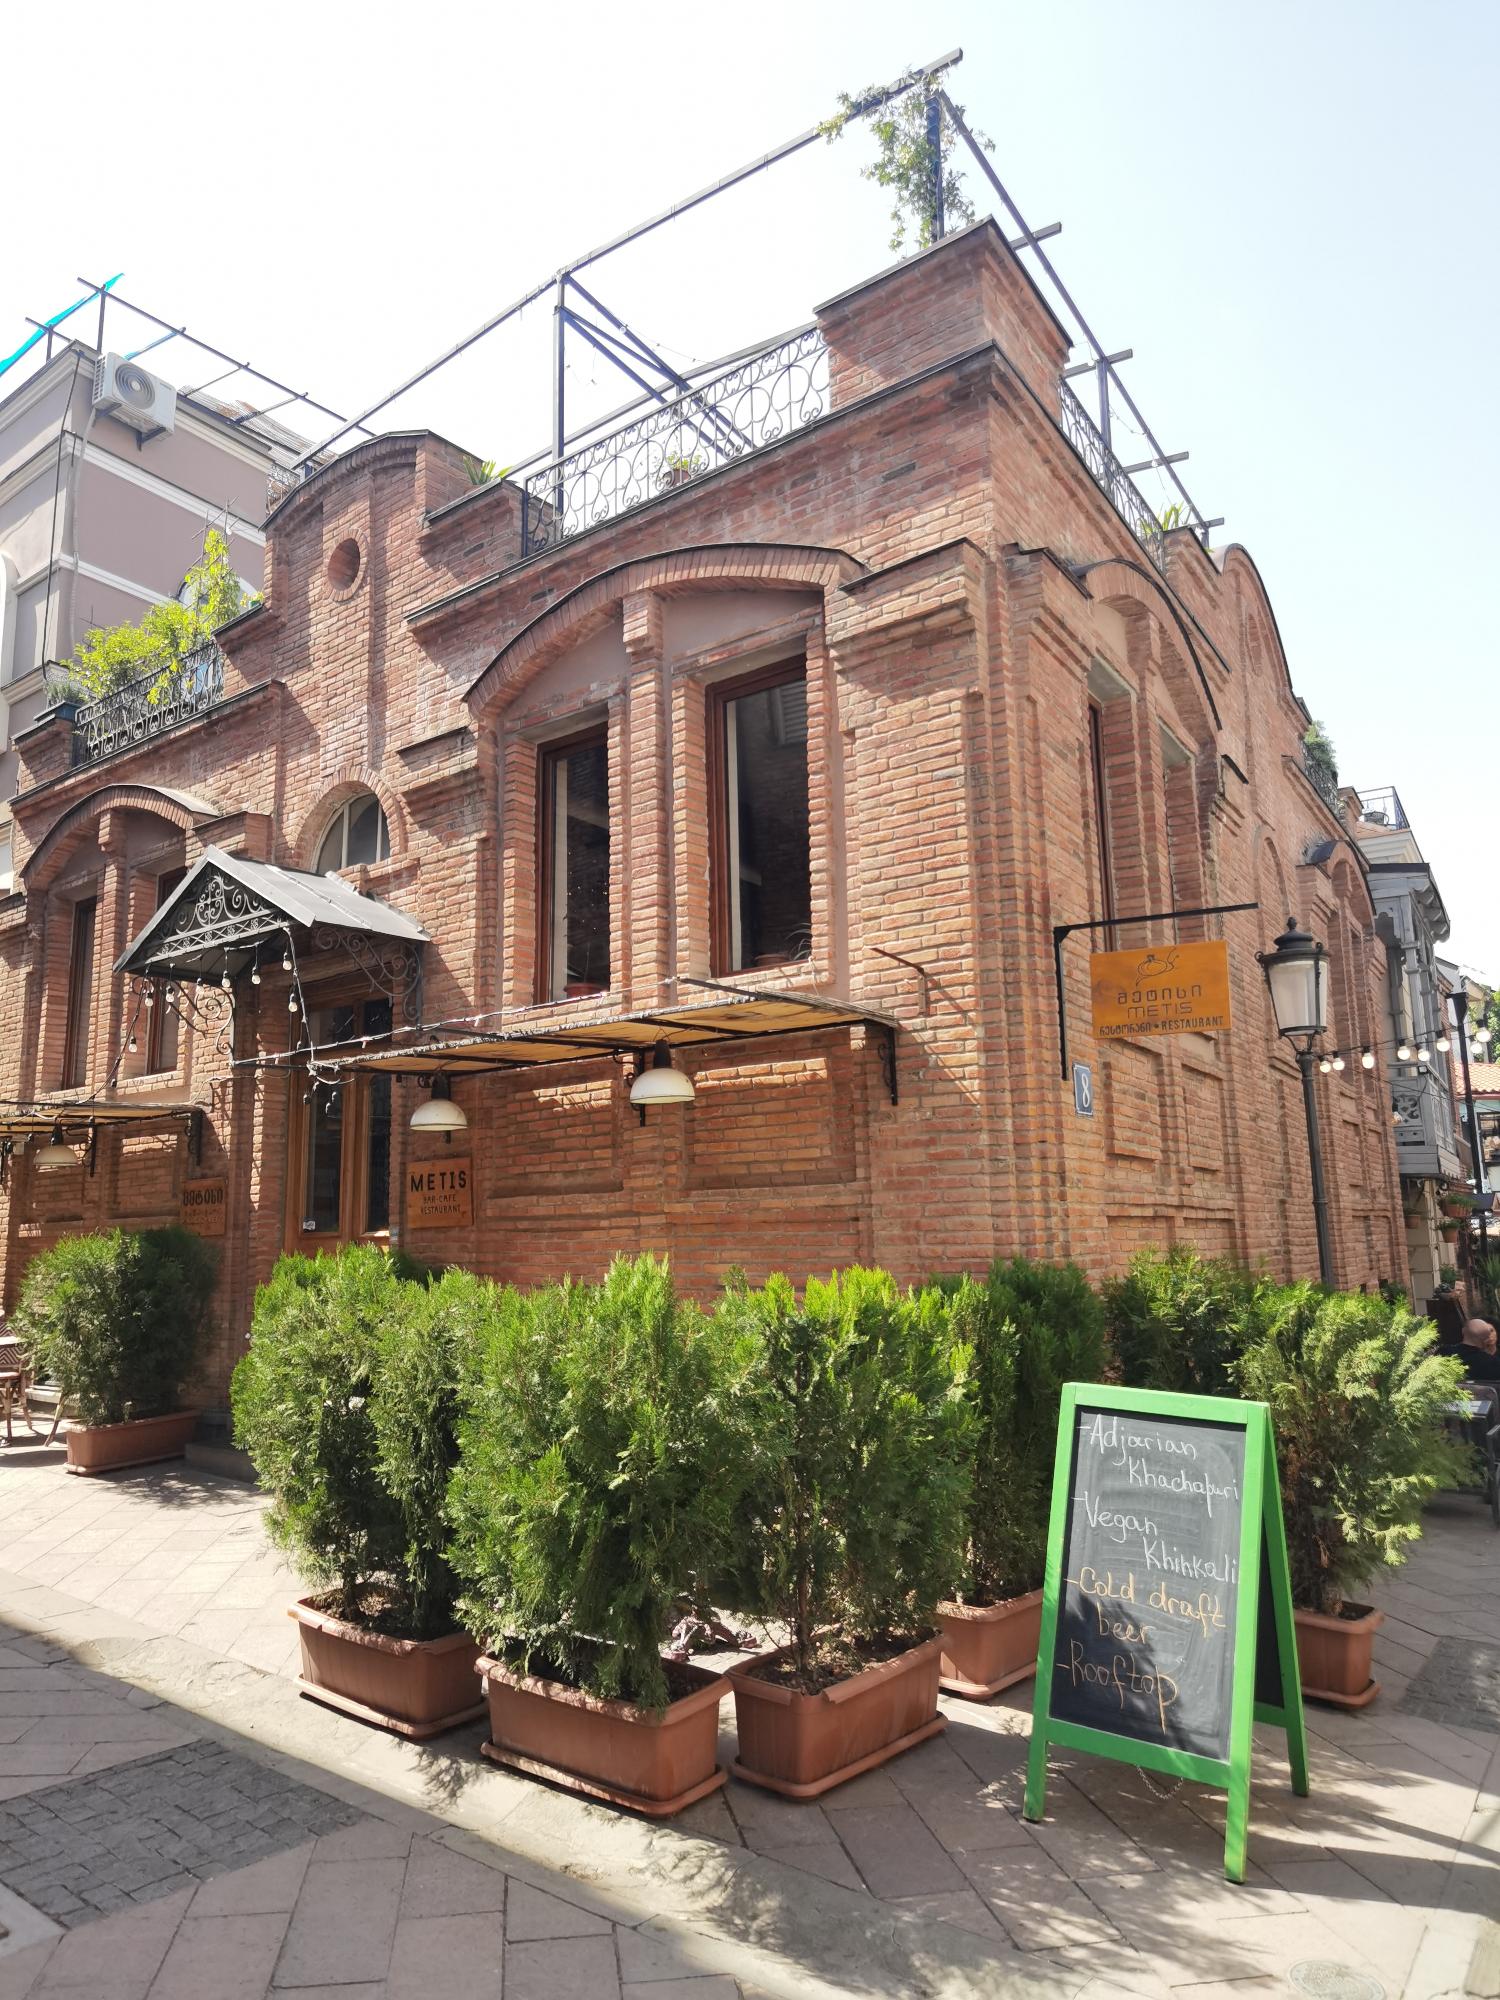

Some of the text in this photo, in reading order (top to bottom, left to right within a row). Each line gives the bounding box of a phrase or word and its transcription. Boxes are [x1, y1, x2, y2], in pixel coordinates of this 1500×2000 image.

[1118, 985, 1202, 1005] მეტისი
[1127, 1002, 1193, 1019] METIS
[1161, 1016, 1224, 1031] RESTAURANT
[1081, 1073, 1090, 1107] 8
[410, 1170, 466, 1192] METIS
[1128, 1456, 1239, 1518] Khachapuri
[1142, 1536, 1238, 1584] Khinkali
[1096, 1601, 1157, 1645] beer
[1149, 1582, 1226, 1638] draft
